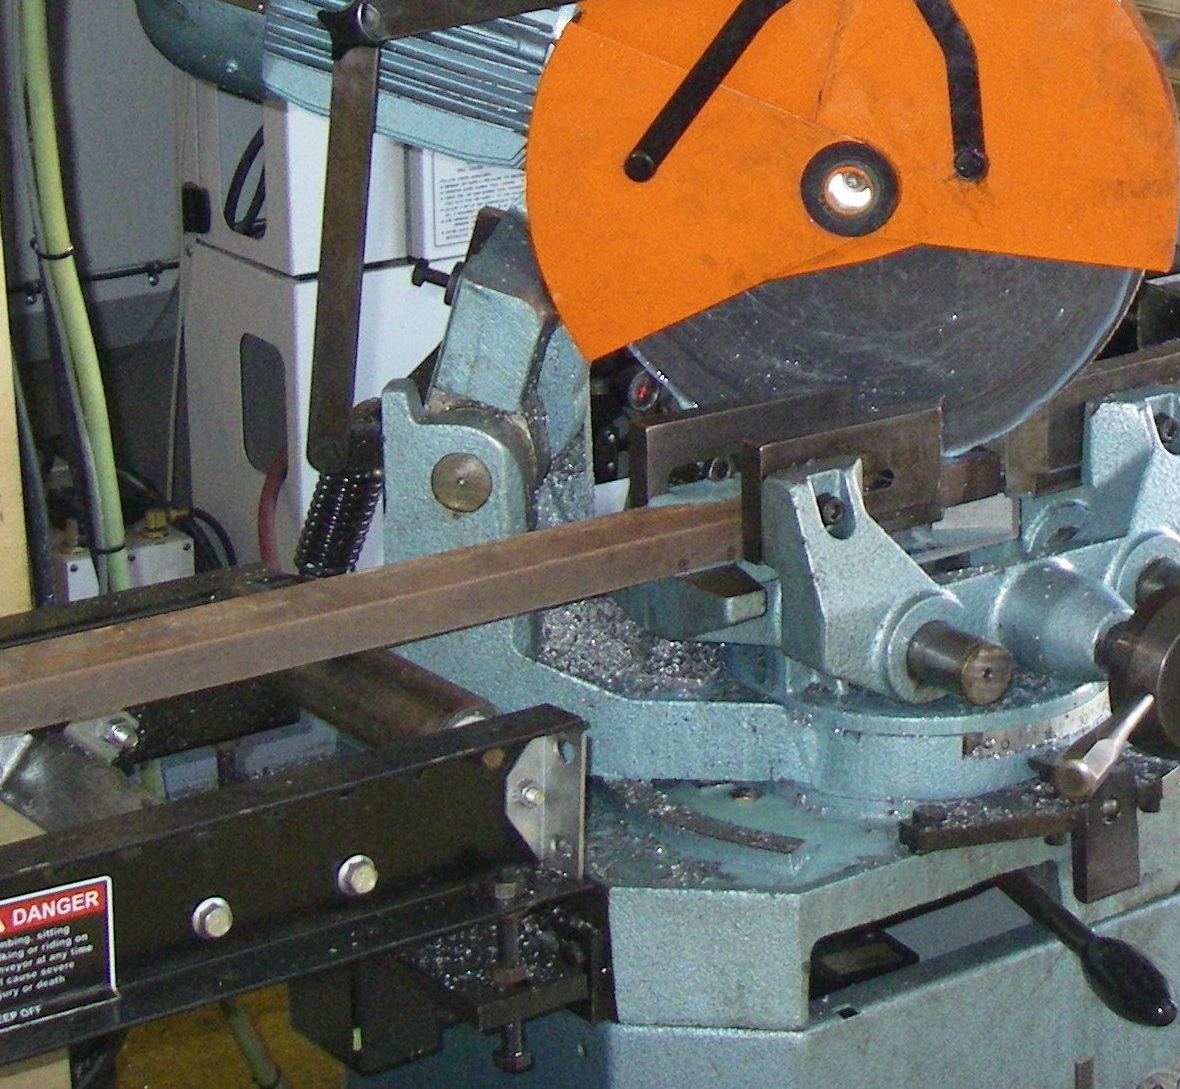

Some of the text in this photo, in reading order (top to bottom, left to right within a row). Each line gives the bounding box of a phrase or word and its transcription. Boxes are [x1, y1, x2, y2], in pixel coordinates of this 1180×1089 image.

[12, 890, 99, 926] DANGER
[36, 925, 71, 940] sitting
[27, 945, 39, 955] or
[41, 936, 72, 952] riding
[74, 933, 89, 944] on
[35, 954, 46, 964] at
[48, 950, 68, 963] any
[70, 944, 94, 957] time
[6, 970, 38, 985] cause
[40, 961, 75, 977] severe
[22, 982, 34, 993] or
[36, 975, 66, 991] death
[20, 1003, 42, 1019] OFF
